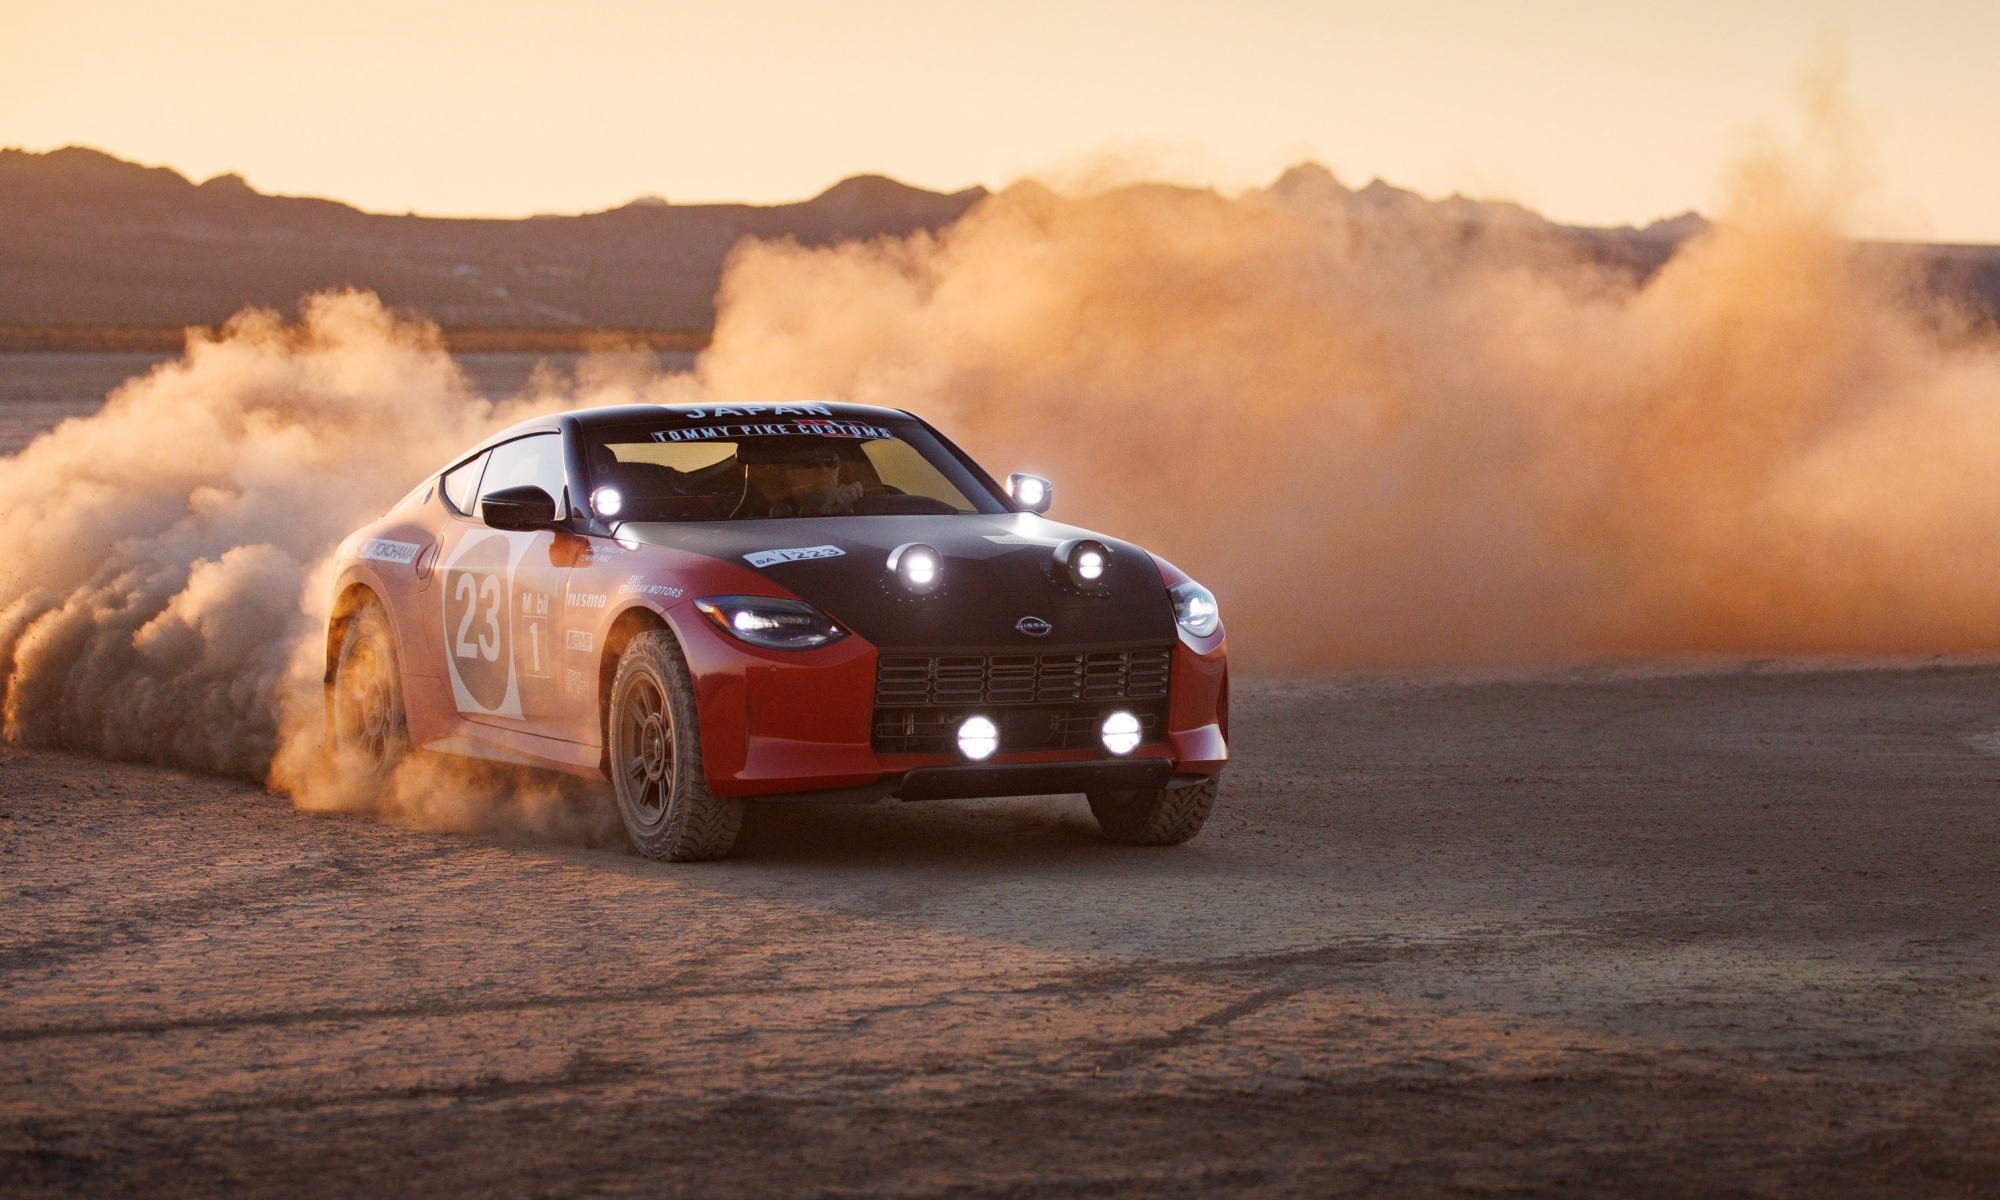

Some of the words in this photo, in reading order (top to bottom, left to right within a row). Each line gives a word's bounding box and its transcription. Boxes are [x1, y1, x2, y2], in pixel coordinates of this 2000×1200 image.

[686, 406, 833, 419] JAPAN
[654, 426, 730, 442] TOMMY
[740, 424, 790, 435] PIKE
[798, 424, 891, 438] CUSTOMS
[372, 542, 417, 560] YOKOHAMA
[648, 585, 684, 598] MOTORS
[455, 572, 501, 662] 23
[1016, 622, 1052, 630] NISSAN
[529, 622, 540, 672] 1
